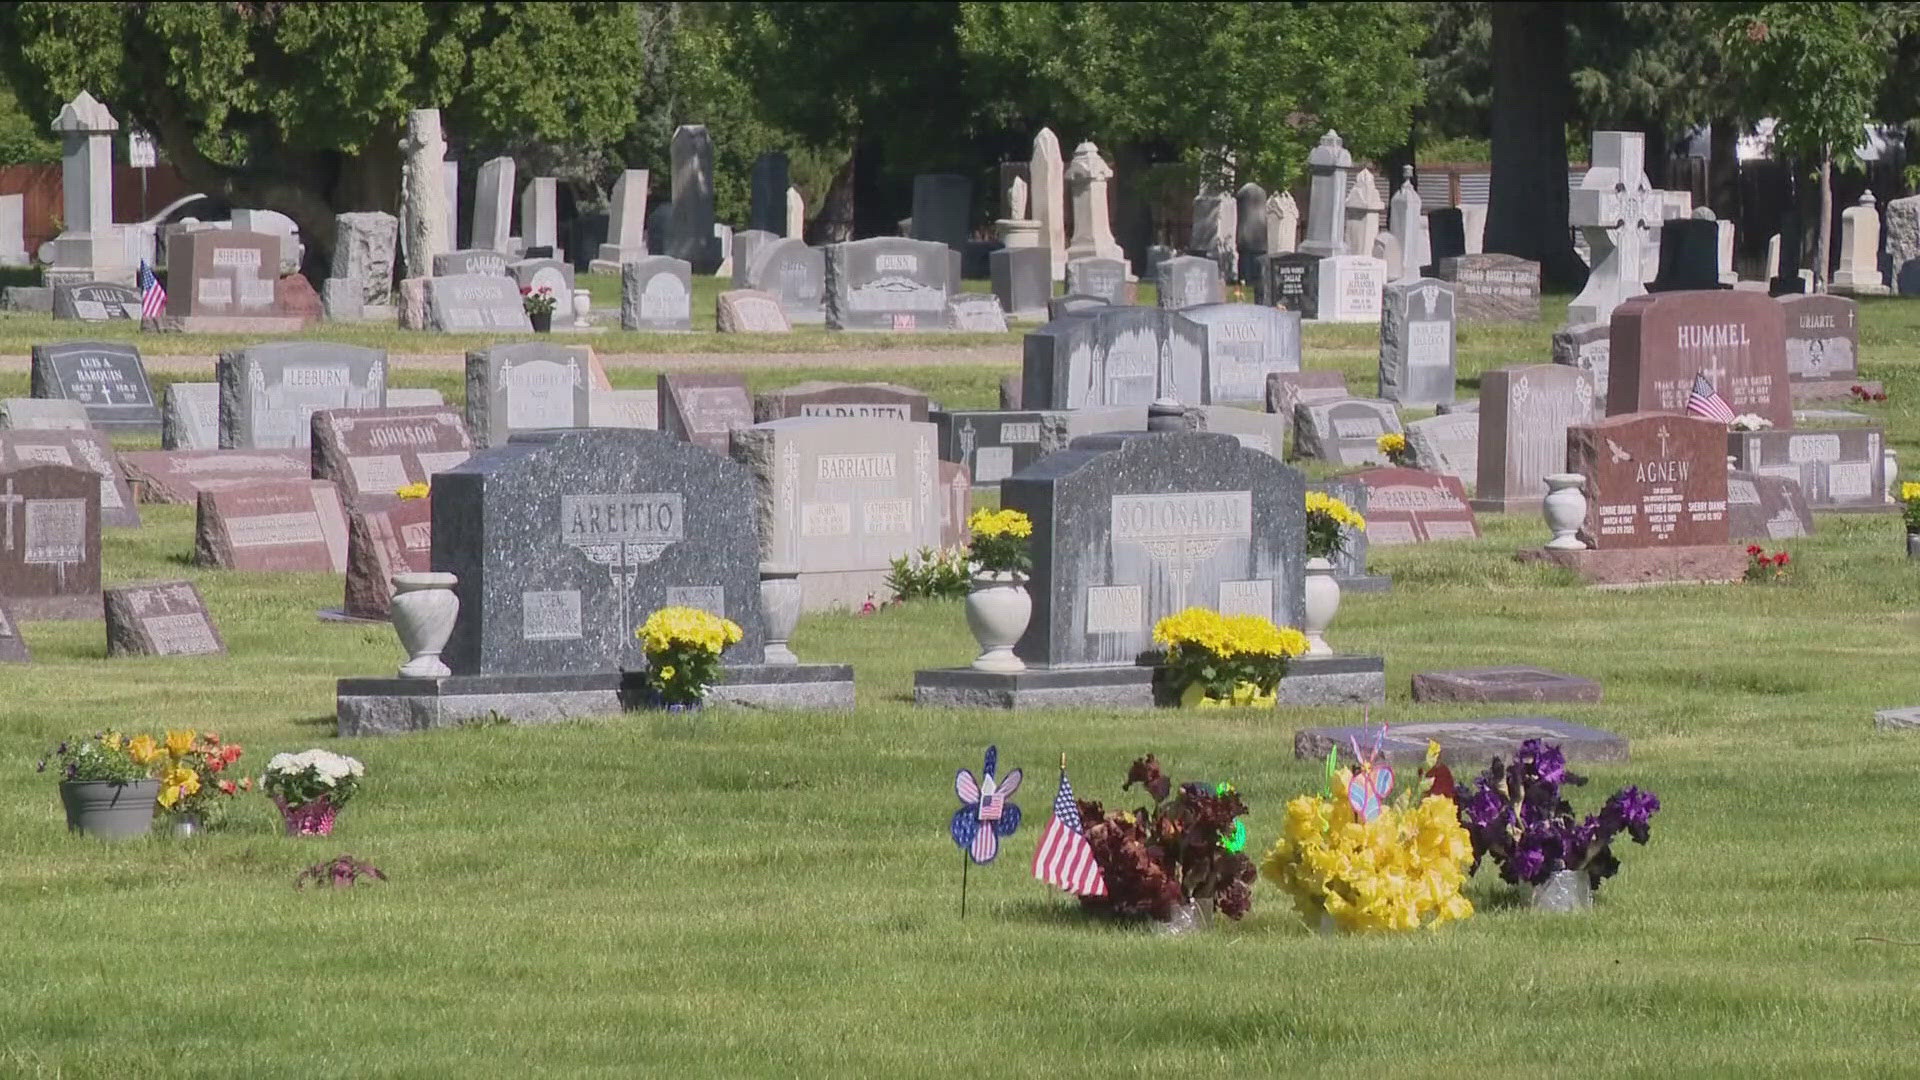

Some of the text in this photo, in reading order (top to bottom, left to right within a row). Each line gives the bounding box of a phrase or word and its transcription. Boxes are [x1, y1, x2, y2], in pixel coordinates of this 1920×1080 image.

[1224, 323, 1257, 341] NIXON
[1677, 323, 1751, 349] HUMMEL
[290, 370, 343, 386] LEEBURN
[368, 424, 439, 450] JOHNSON
[821, 457, 893, 479] BARRIATUA
[1636, 460, 1690, 482] AGNEW
[1384, 490, 1432, 507] PARKER
[570, 502, 674, 534] AREITIO
